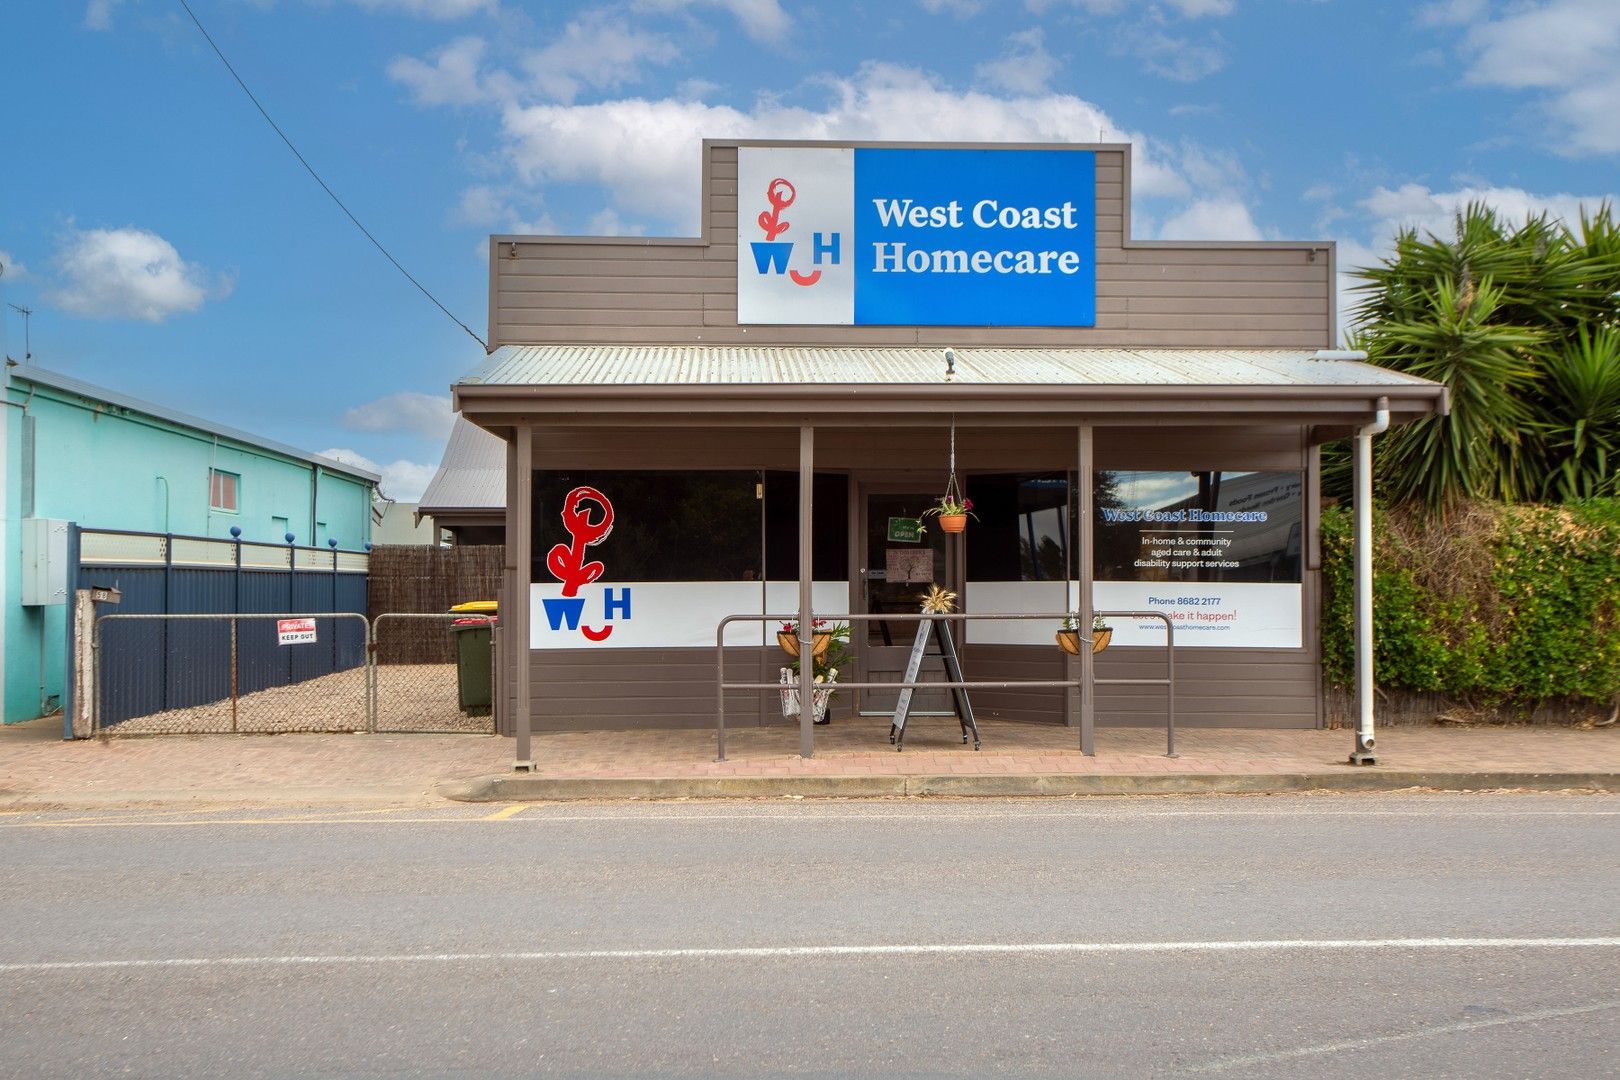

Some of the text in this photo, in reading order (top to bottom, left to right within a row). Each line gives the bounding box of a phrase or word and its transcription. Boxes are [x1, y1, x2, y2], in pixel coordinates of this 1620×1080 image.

[872, 199, 1077, 230] West Coast
[872, 242, 1080, 275] Homecare
[1102, 508, 1268, 522] West Coast Homecare
[1142, 537, 1232, 548] In-home & community
[1151, 549, 1172, 558] aged
[1193, 549, 1199, 557] &
[1201, 549, 1222, 557] adult
[1134, 560, 1240, 569] disability support services
[1148, 597, 1221, 606] Phone 8682 2177
[1187, 610, 1194, 621] it
[1196, 610, 1237, 622] happen!
